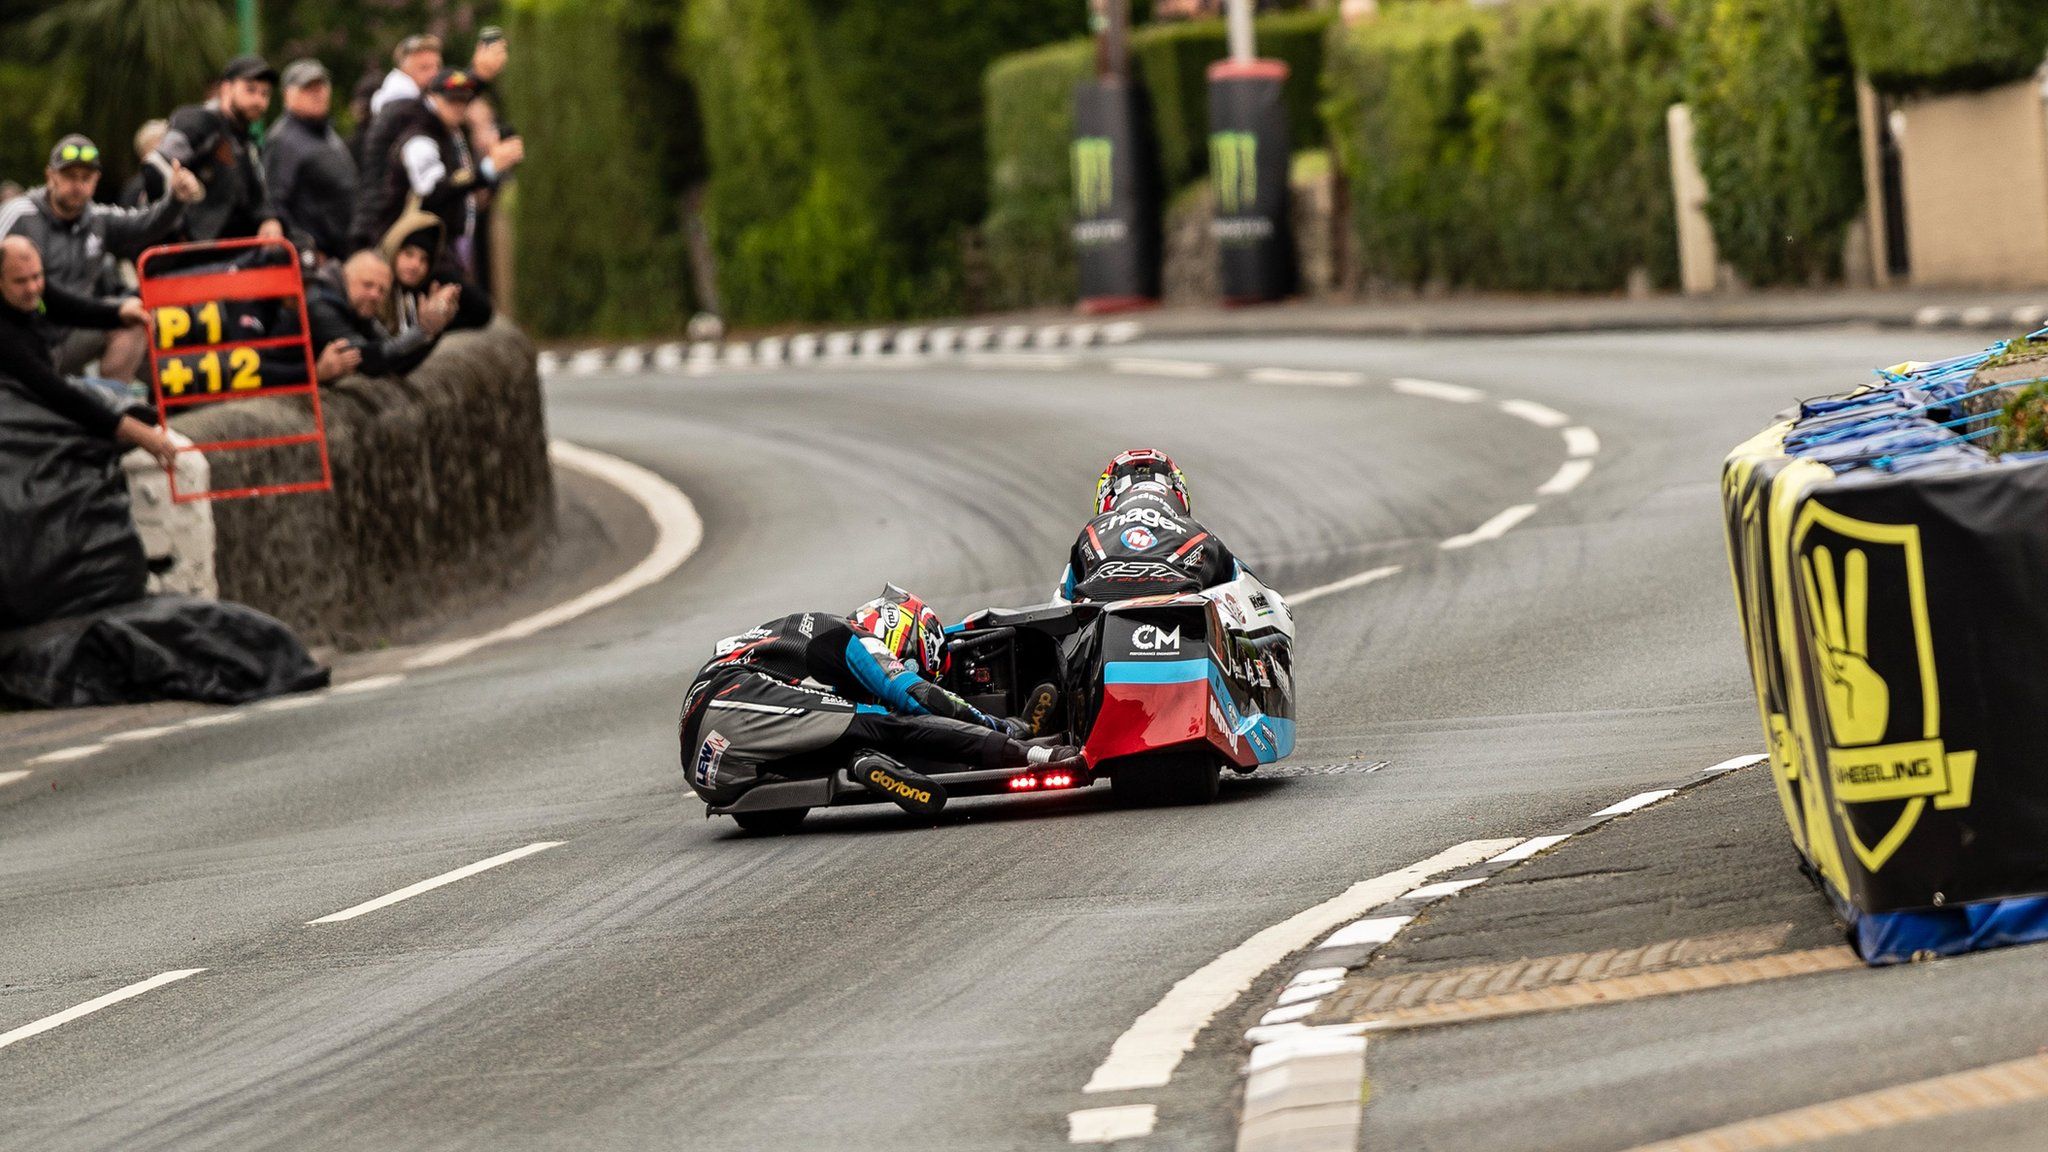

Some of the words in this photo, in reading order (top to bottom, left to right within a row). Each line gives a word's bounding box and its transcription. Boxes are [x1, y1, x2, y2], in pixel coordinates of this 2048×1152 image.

[157, 300, 222, 350] P1
[161, 346, 263, 394] +12
[1131, 623, 1180, 650] CM
[869, 768, 932, 804] daytona
